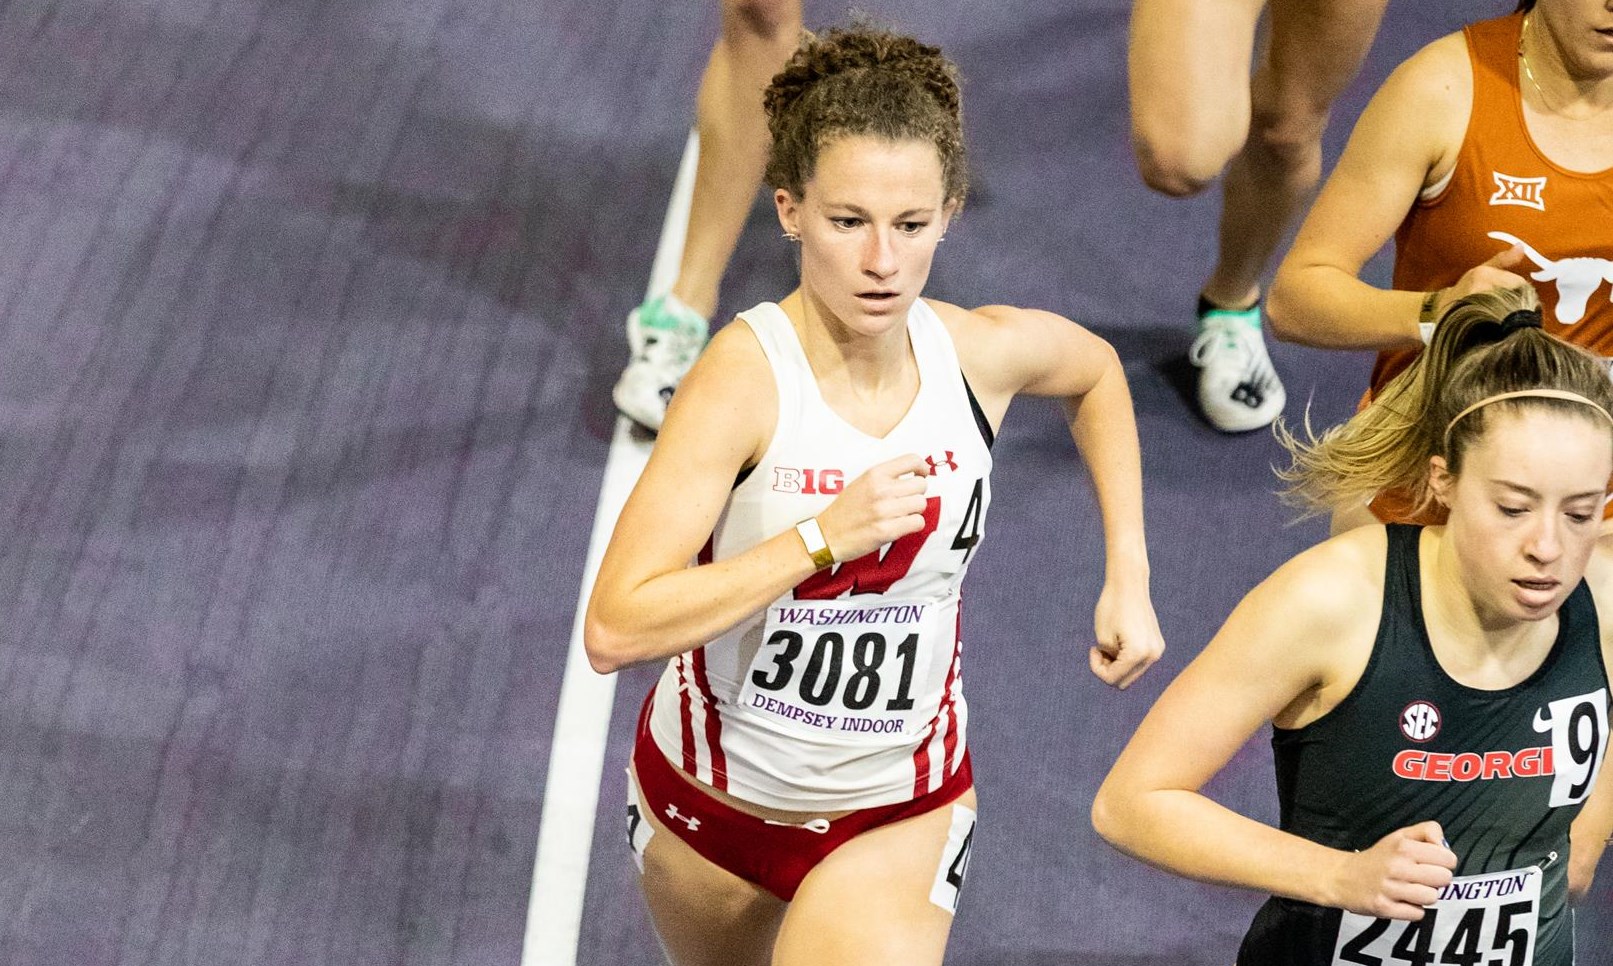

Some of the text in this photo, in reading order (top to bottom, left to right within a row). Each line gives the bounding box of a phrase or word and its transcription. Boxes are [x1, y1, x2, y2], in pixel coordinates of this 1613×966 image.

[950, 477, 982, 565] 4
[779, 605, 925, 626] WASHINGTON
[752, 630, 920, 711] 3081
[752, 693, 904, 733] DEMPSEY INDOOR
[1402, 703, 1439, 740] SEC
[1392, 746, 1555, 781] GEORGI
[1568, 701, 1600, 799] 9
[946, 820, 975, 909] 4
[1438, 873, 1527, 900] INGTON
[1339, 900, 1533, 966] 2445
